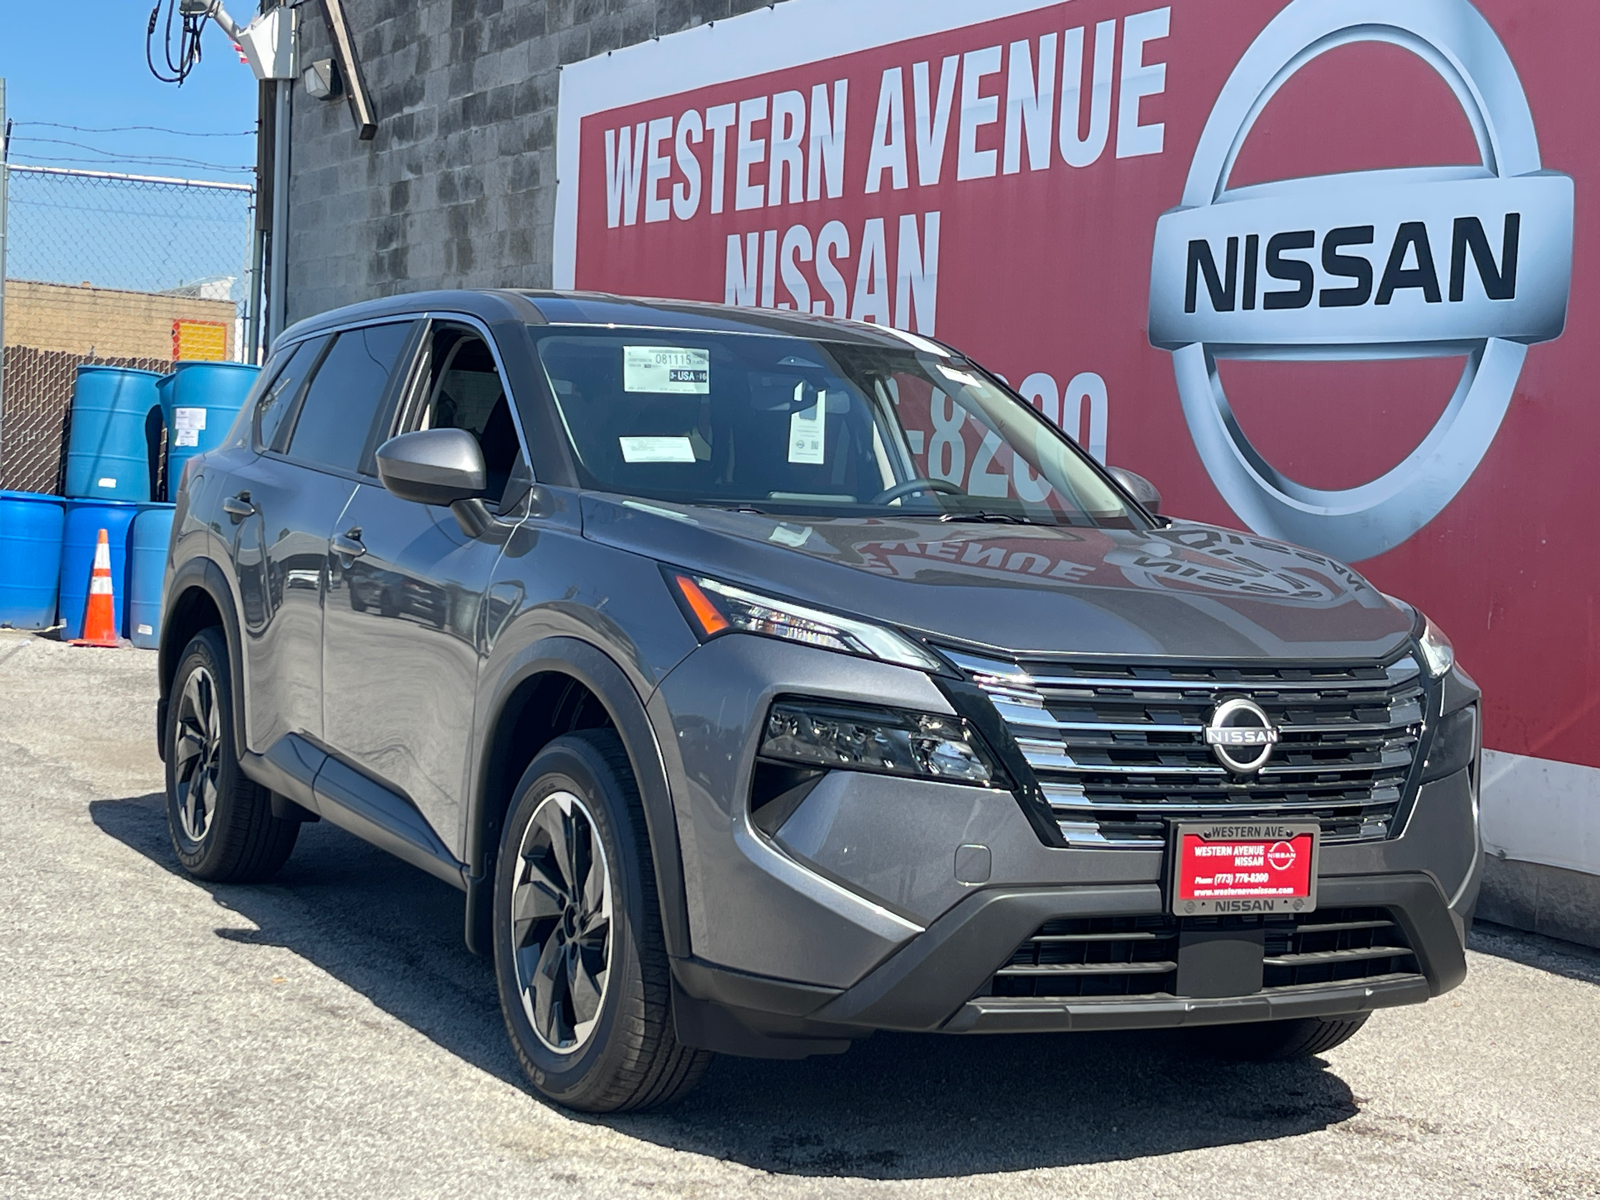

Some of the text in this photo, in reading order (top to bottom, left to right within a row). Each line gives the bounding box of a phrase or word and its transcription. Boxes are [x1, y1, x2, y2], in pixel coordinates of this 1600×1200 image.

[604, 6, 1172, 229] WESTERN AVENUE
[1184, 212, 1521, 313] NISSAN
[724, 211, 941, 337] NISSAN
[656, 354, 692, 365] 081115
[677, 371, 695, 380] USA
[1208, 730, 1278, 743] NISSAN
[1212, 826, 1261, 838] WESTERN
[1194, 845, 1265, 856] WESTERN AVENUE
[1234, 857, 1264, 867] NISSAN
[1214, 873, 1234, 886] (773)
[1215, 900, 1274, 912] NISSAN
